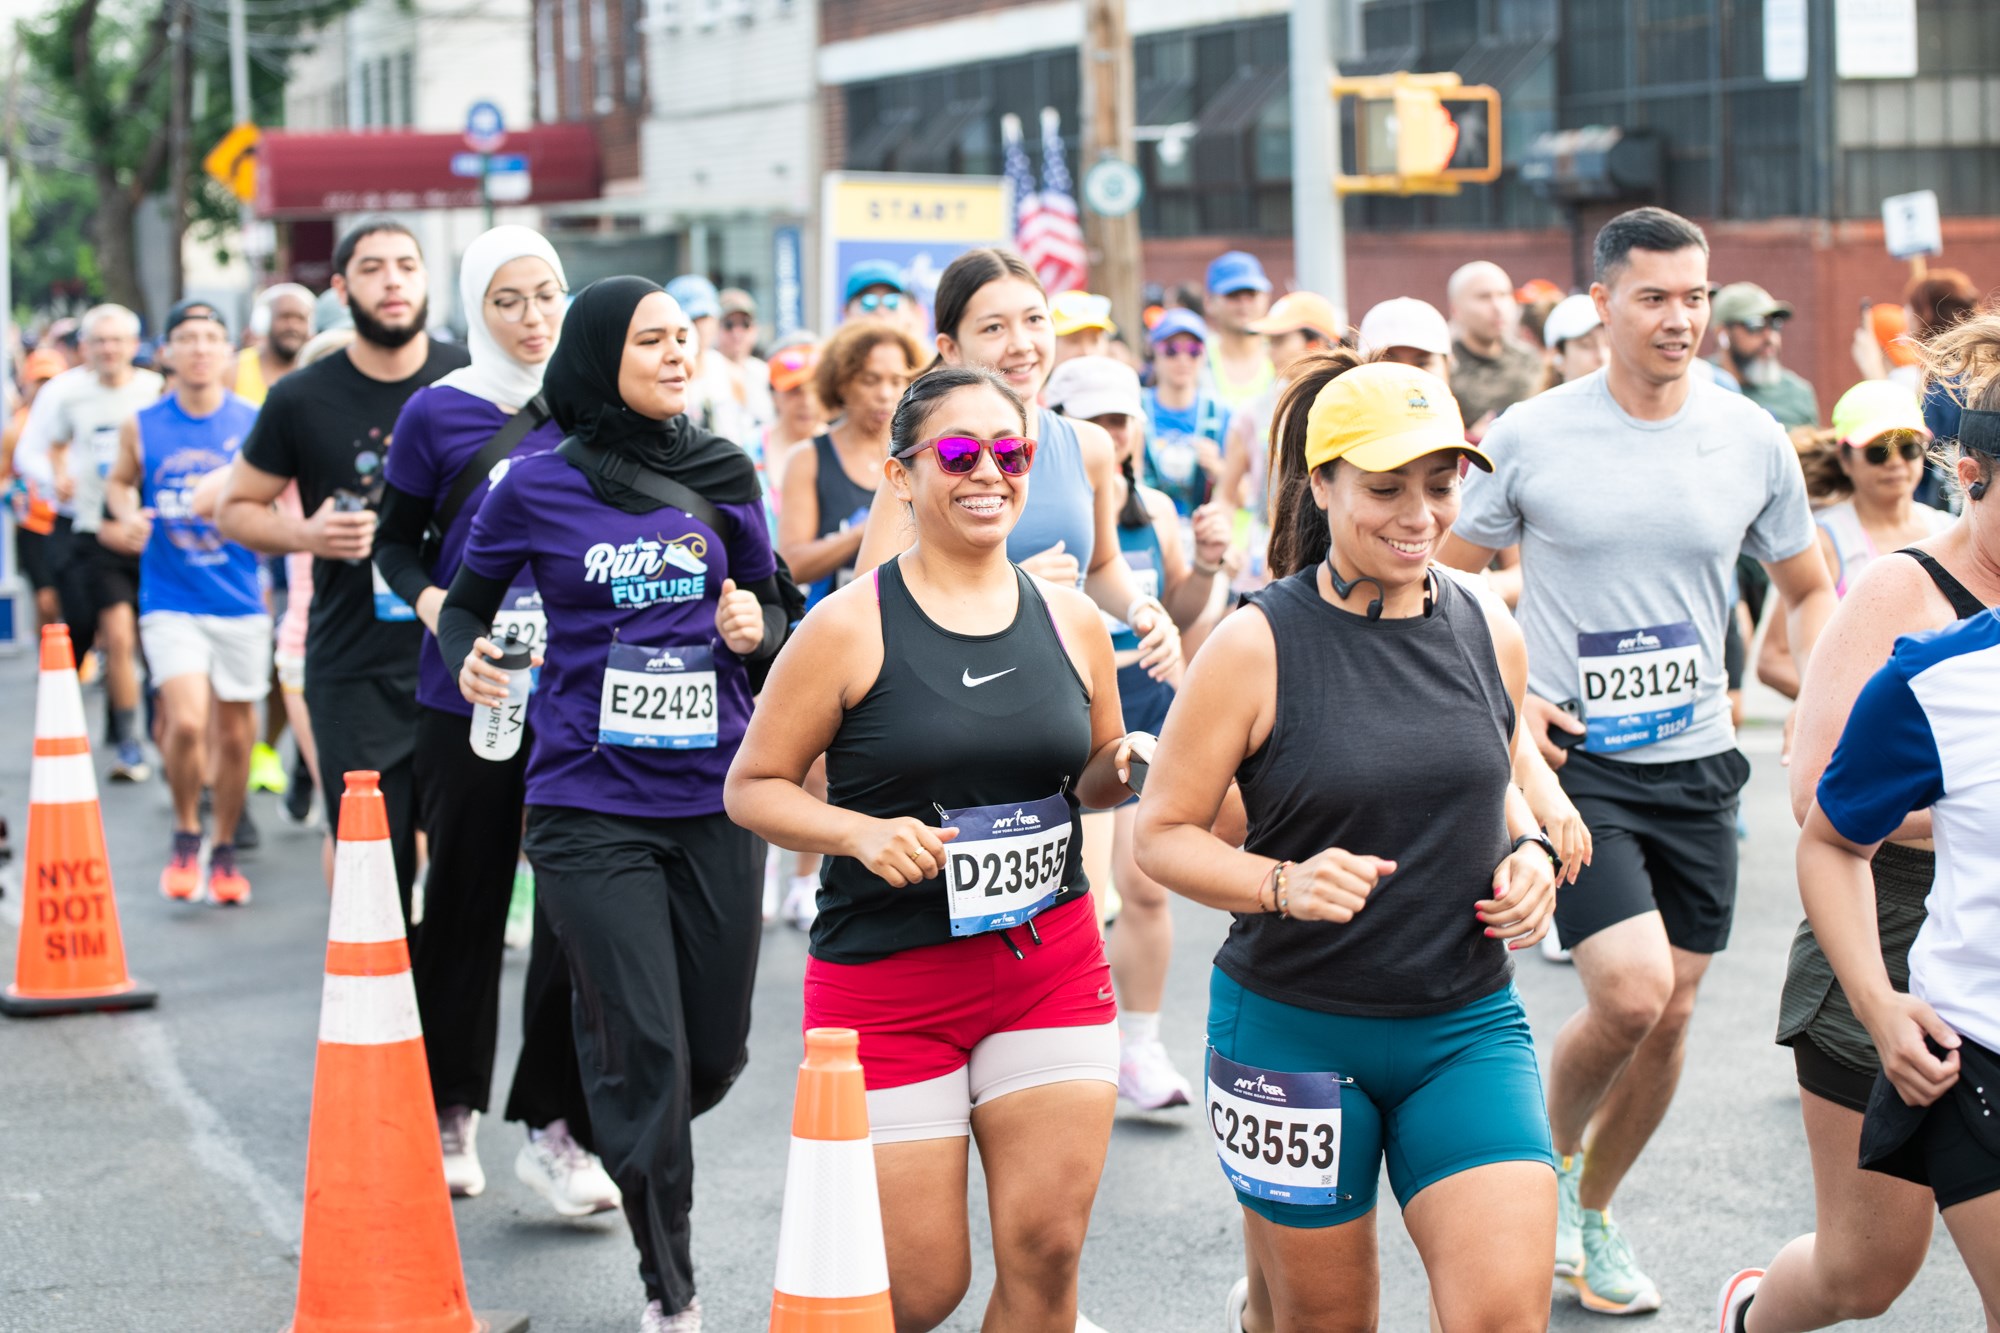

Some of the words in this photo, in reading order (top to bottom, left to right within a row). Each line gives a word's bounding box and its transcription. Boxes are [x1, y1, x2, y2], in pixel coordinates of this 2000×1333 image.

[868, 199, 968, 220] START
[584, 542, 662, 584] Run
[611, 575, 706, 604] FUTURE
[1584, 658, 1699, 701] D23124
[611, 684, 713, 720] E22423
[38, 860, 105, 889] NYC
[952, 836, 1068, 897] D23555
[38, 893, 106, 925] DOT
[45, 930, 107, 961] SIM
[1211, 1101, 1334, 1170] C23553
